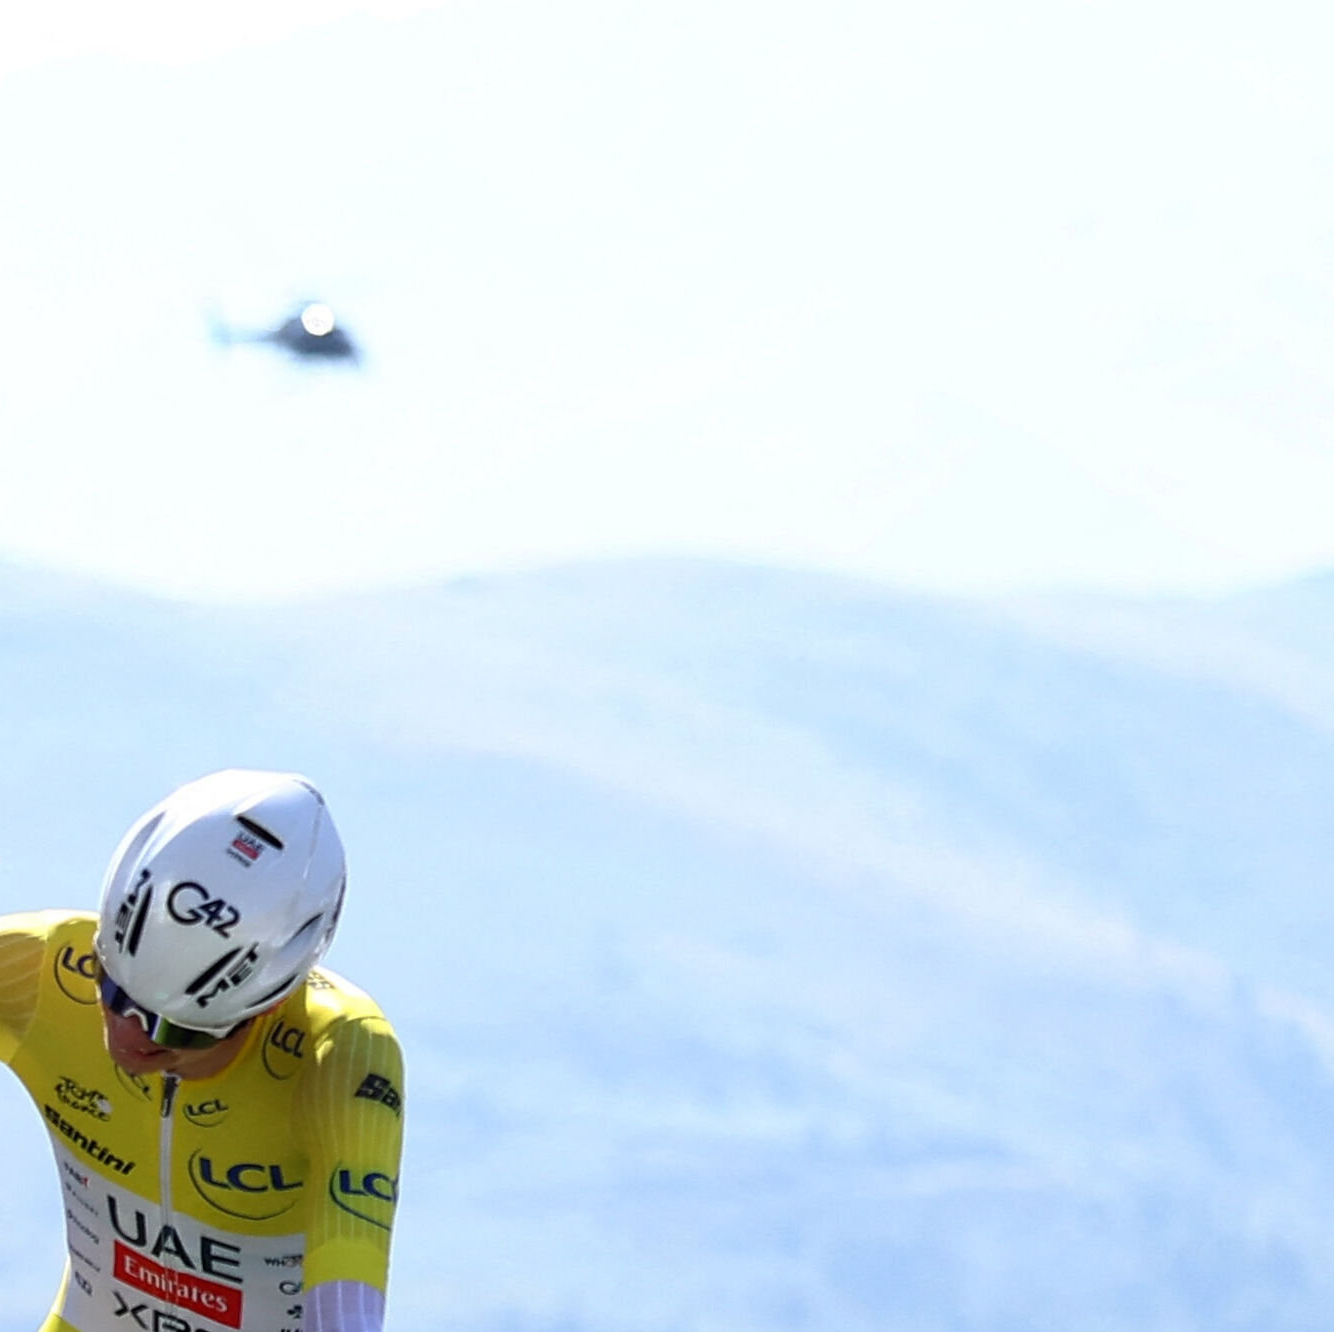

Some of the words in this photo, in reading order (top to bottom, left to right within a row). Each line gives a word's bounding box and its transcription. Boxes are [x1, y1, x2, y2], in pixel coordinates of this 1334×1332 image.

[167, 881, 241, 939] G42
[62, 945, 97, 980] LC
[185, 1098, 229, 1117] LCL
[44, 1103, 136, 1175] Santini
[198, 1157, 304, 1193] LCL
[339, 1170, 400, 1201] LC
[107, 1194, 243, 1284] UAE
[123, 1254, 229, 1313] Emirates
